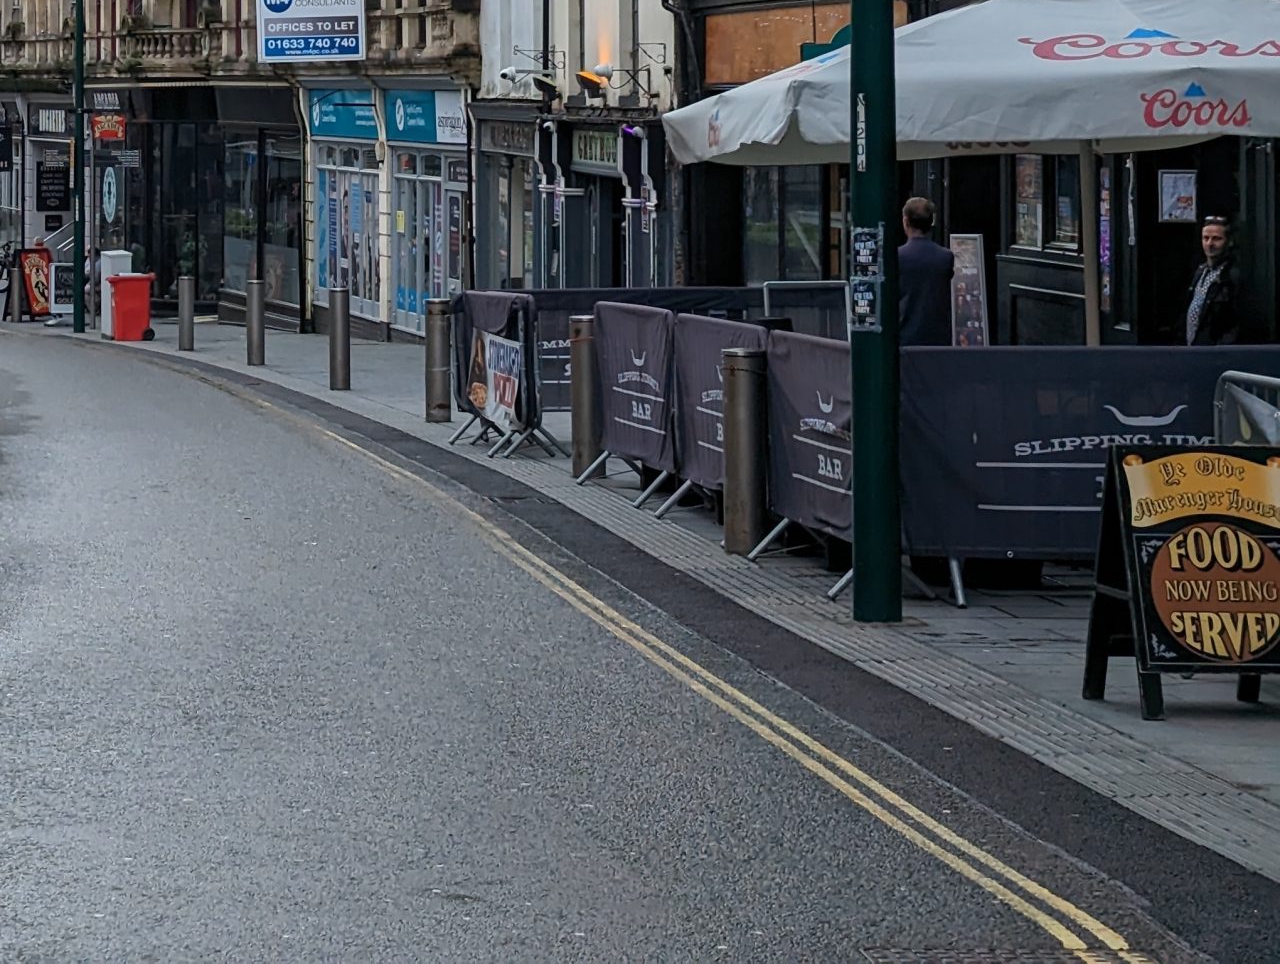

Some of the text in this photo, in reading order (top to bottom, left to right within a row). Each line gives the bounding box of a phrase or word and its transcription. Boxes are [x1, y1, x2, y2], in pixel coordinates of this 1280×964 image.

[268, 21, 355, 32] OFFICES TO LET
[268, 38, 356, 49] 01633 740 740
[1018, 34, 1280, 62] Coors
[1140, 88, 1252, 129] Coors
[631, 400, 652, 421] BAR
[1014, 434, 1153, 457] SLIPPING
[817, 453, 844, 481] BAR
[1159, 455, 1245, 487] Ye Olde
[1133, 491, 1223, 522] Murenger
[1168, 526, 1262, 570] FOOD
[1165, 579, 1280, 602] NOW BEING
[1169, 610, 1280, 660] SERVED
